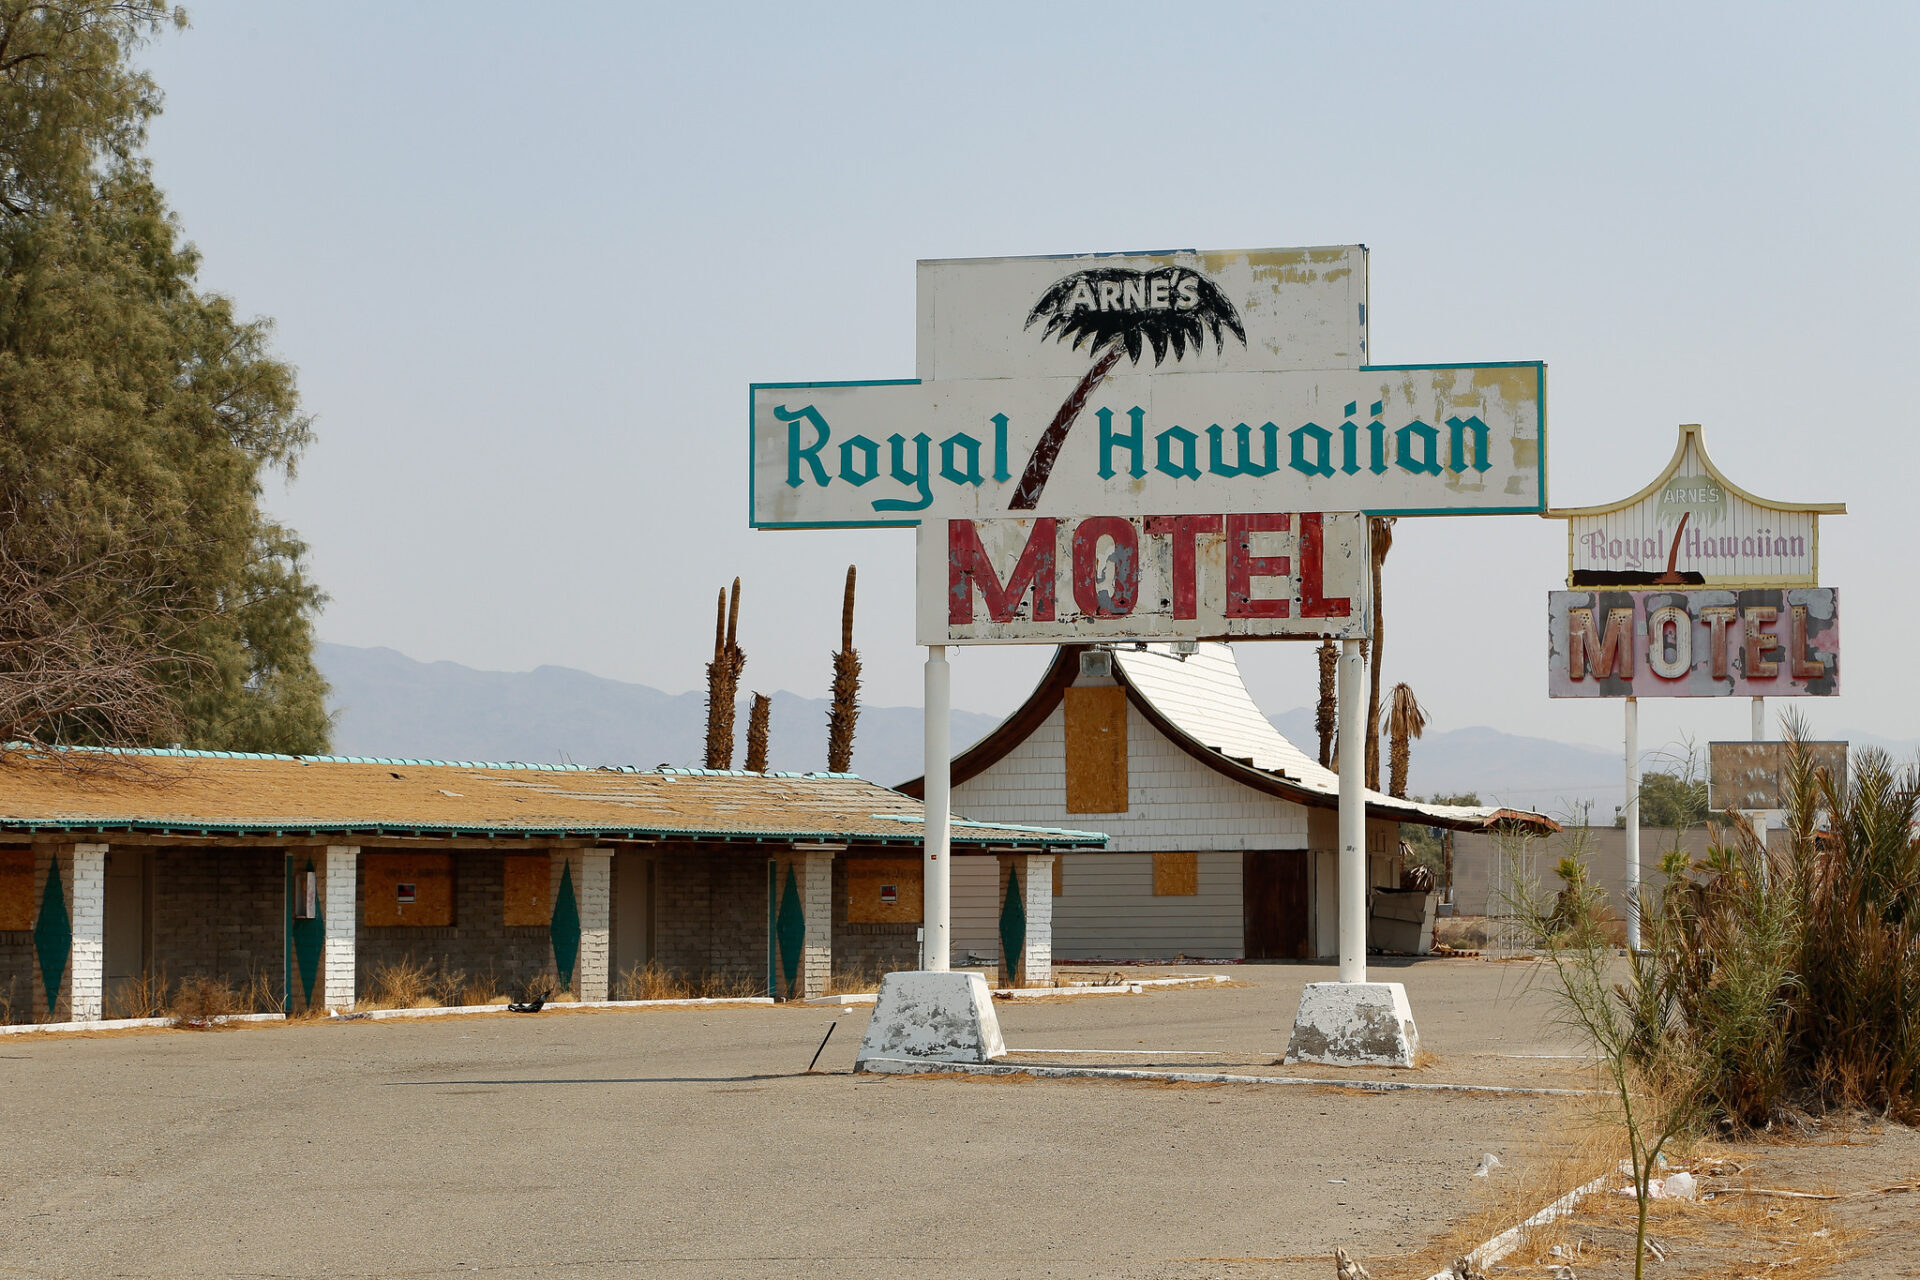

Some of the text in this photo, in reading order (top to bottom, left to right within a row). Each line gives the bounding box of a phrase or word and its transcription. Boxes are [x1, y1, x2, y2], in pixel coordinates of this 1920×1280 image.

[1069, 271, 1200, 313] ARNE'S
[773, 400, 1493, 512] Royal Hawaiian
[1663, 484, 1720, 504] ARNE'S
[947, 512, 1352, 625] MOTEL
[1580, 527, 1806, 568] Royal Hawaiian
[1568, 605, 1826, 681] MOTEL
